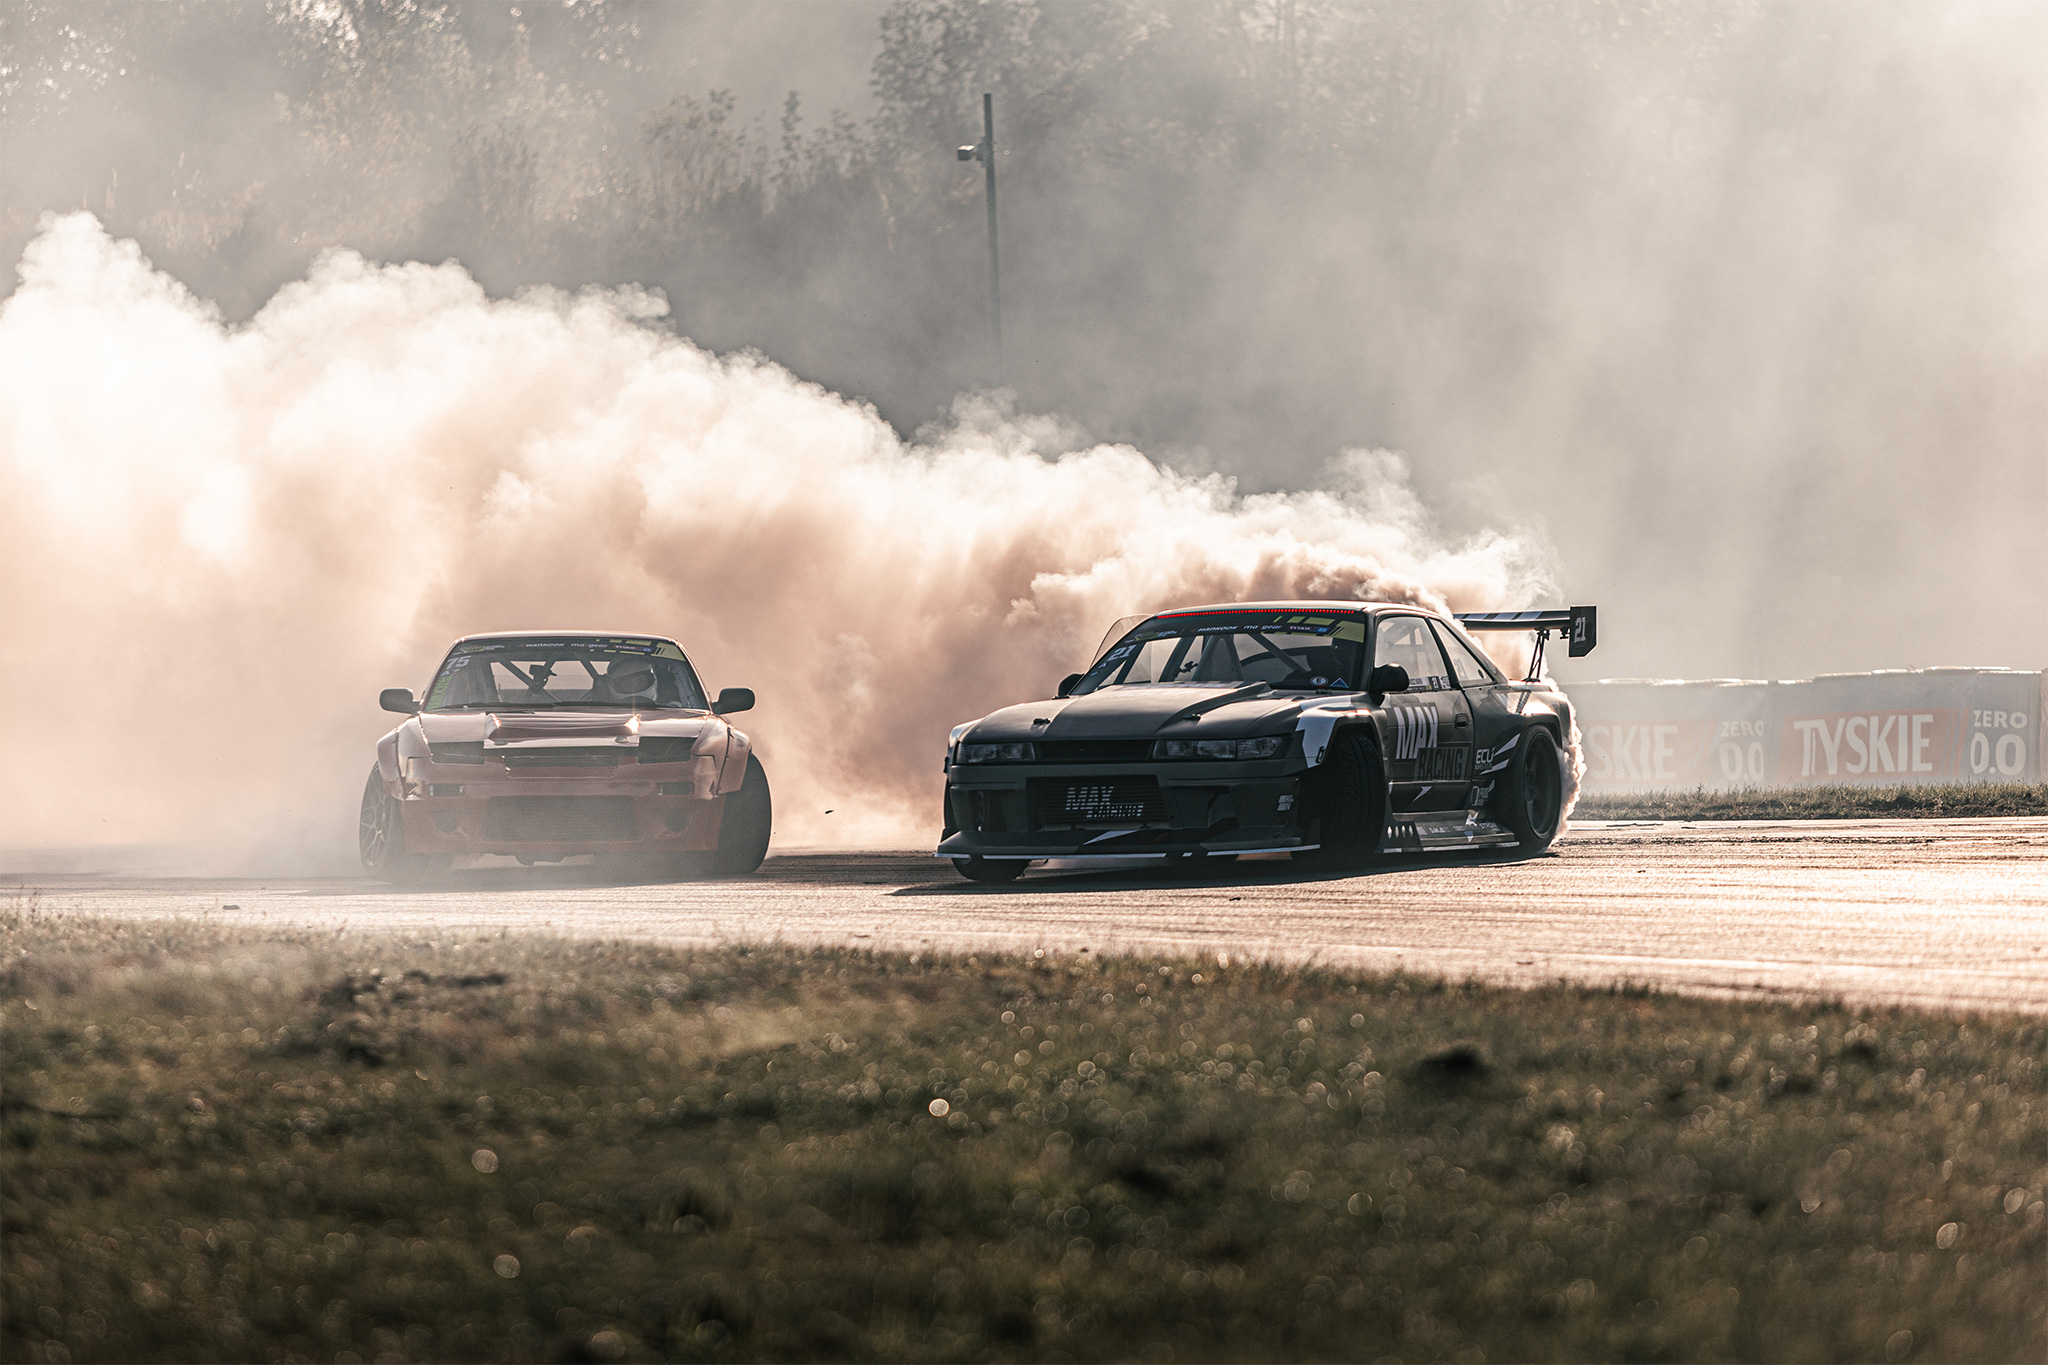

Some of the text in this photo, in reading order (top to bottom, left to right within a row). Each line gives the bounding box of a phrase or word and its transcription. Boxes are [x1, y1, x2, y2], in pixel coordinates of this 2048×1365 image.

[1574, 616, 1586, 643] 21
[445, 655, 472, 670] 75
[1107, 644, 1137, 662] 21
[1394, 706, 1438, 760] MAX
[1720, 719, 1765, 738] ZERO
[1973, 710, 2028, 729] ZERO
[1475, 748, 1494, 764] ECU
[1583, 724, 1679, 781] SKIE
[1794, 714, 1934, 775] TYSKIE
[1970, 733, 2027, 776] 0.0
[1417, 747, 1466, 780] RACING
[1719, 741, 1765, 781] 0.0
[1065, 786, 1114, 810] MAX
